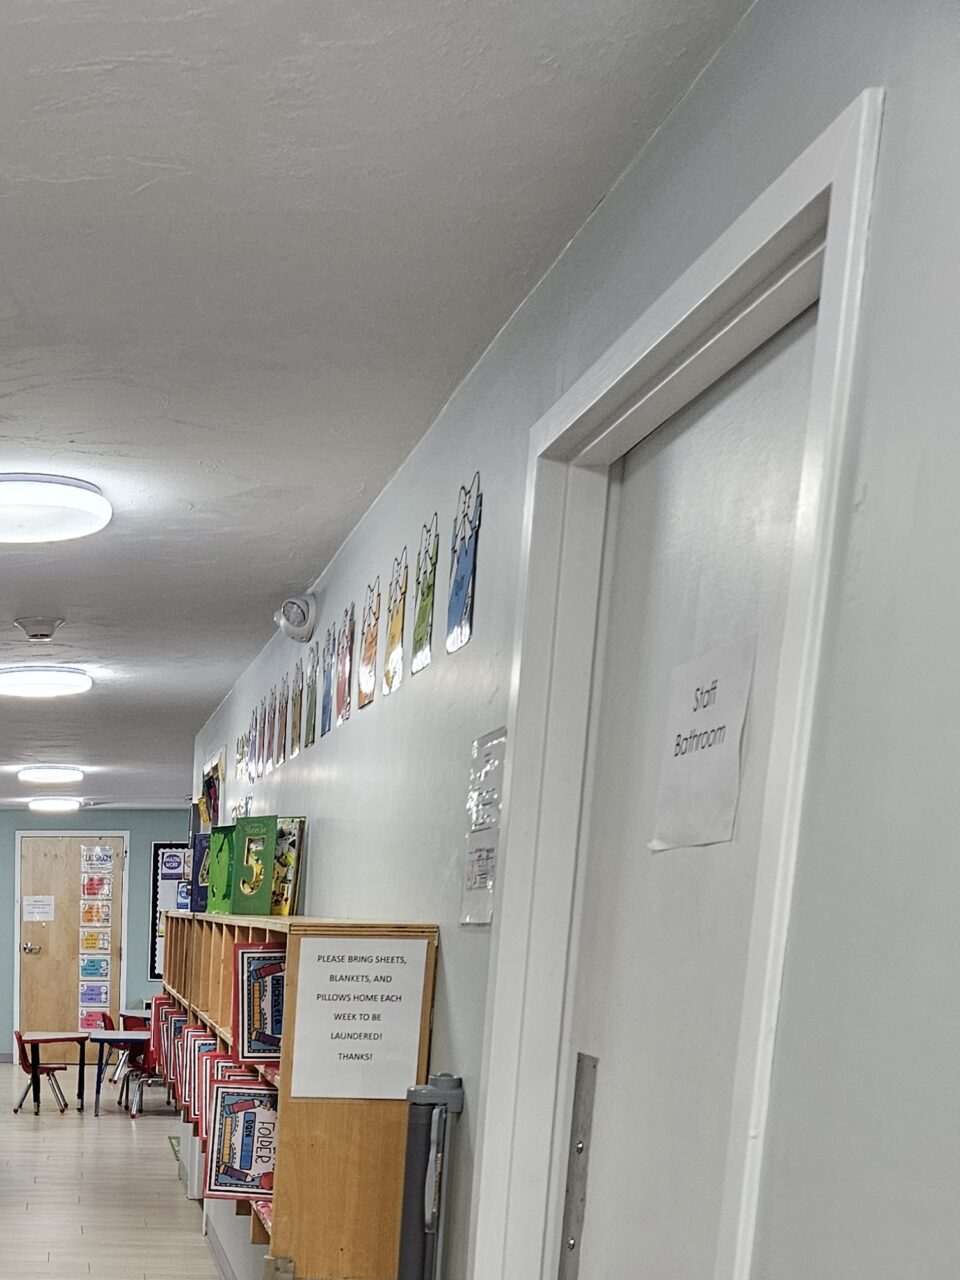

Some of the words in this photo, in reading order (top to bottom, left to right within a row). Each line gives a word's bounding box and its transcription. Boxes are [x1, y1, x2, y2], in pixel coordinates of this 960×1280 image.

[693, 679, 719, 712] Staff
[673, 725, 726, 758] Bathroom
[317, 955, 345, 963] PLEASE
[348, 955, 373, 964] BRING
[375, 956, 407, 965] SHEETS,
[329, 974, 371, 983] BLANKETS,
[373, 975, 392, 983] AND
[316, 994, 351, 1002] PILLOWS
[353, 994, 378, 1002] HOME
[380, 995, 402, 1003] EACH
[333, 1013, 357, 1021] WEEK
[359, 1013, 370, 1021] TO
[330, 1032, 383, 1041] LAUNDERED!
[338, 1052, 373, 1061] THANKS!
[257, 1121, 276, 1164] FOLDER
